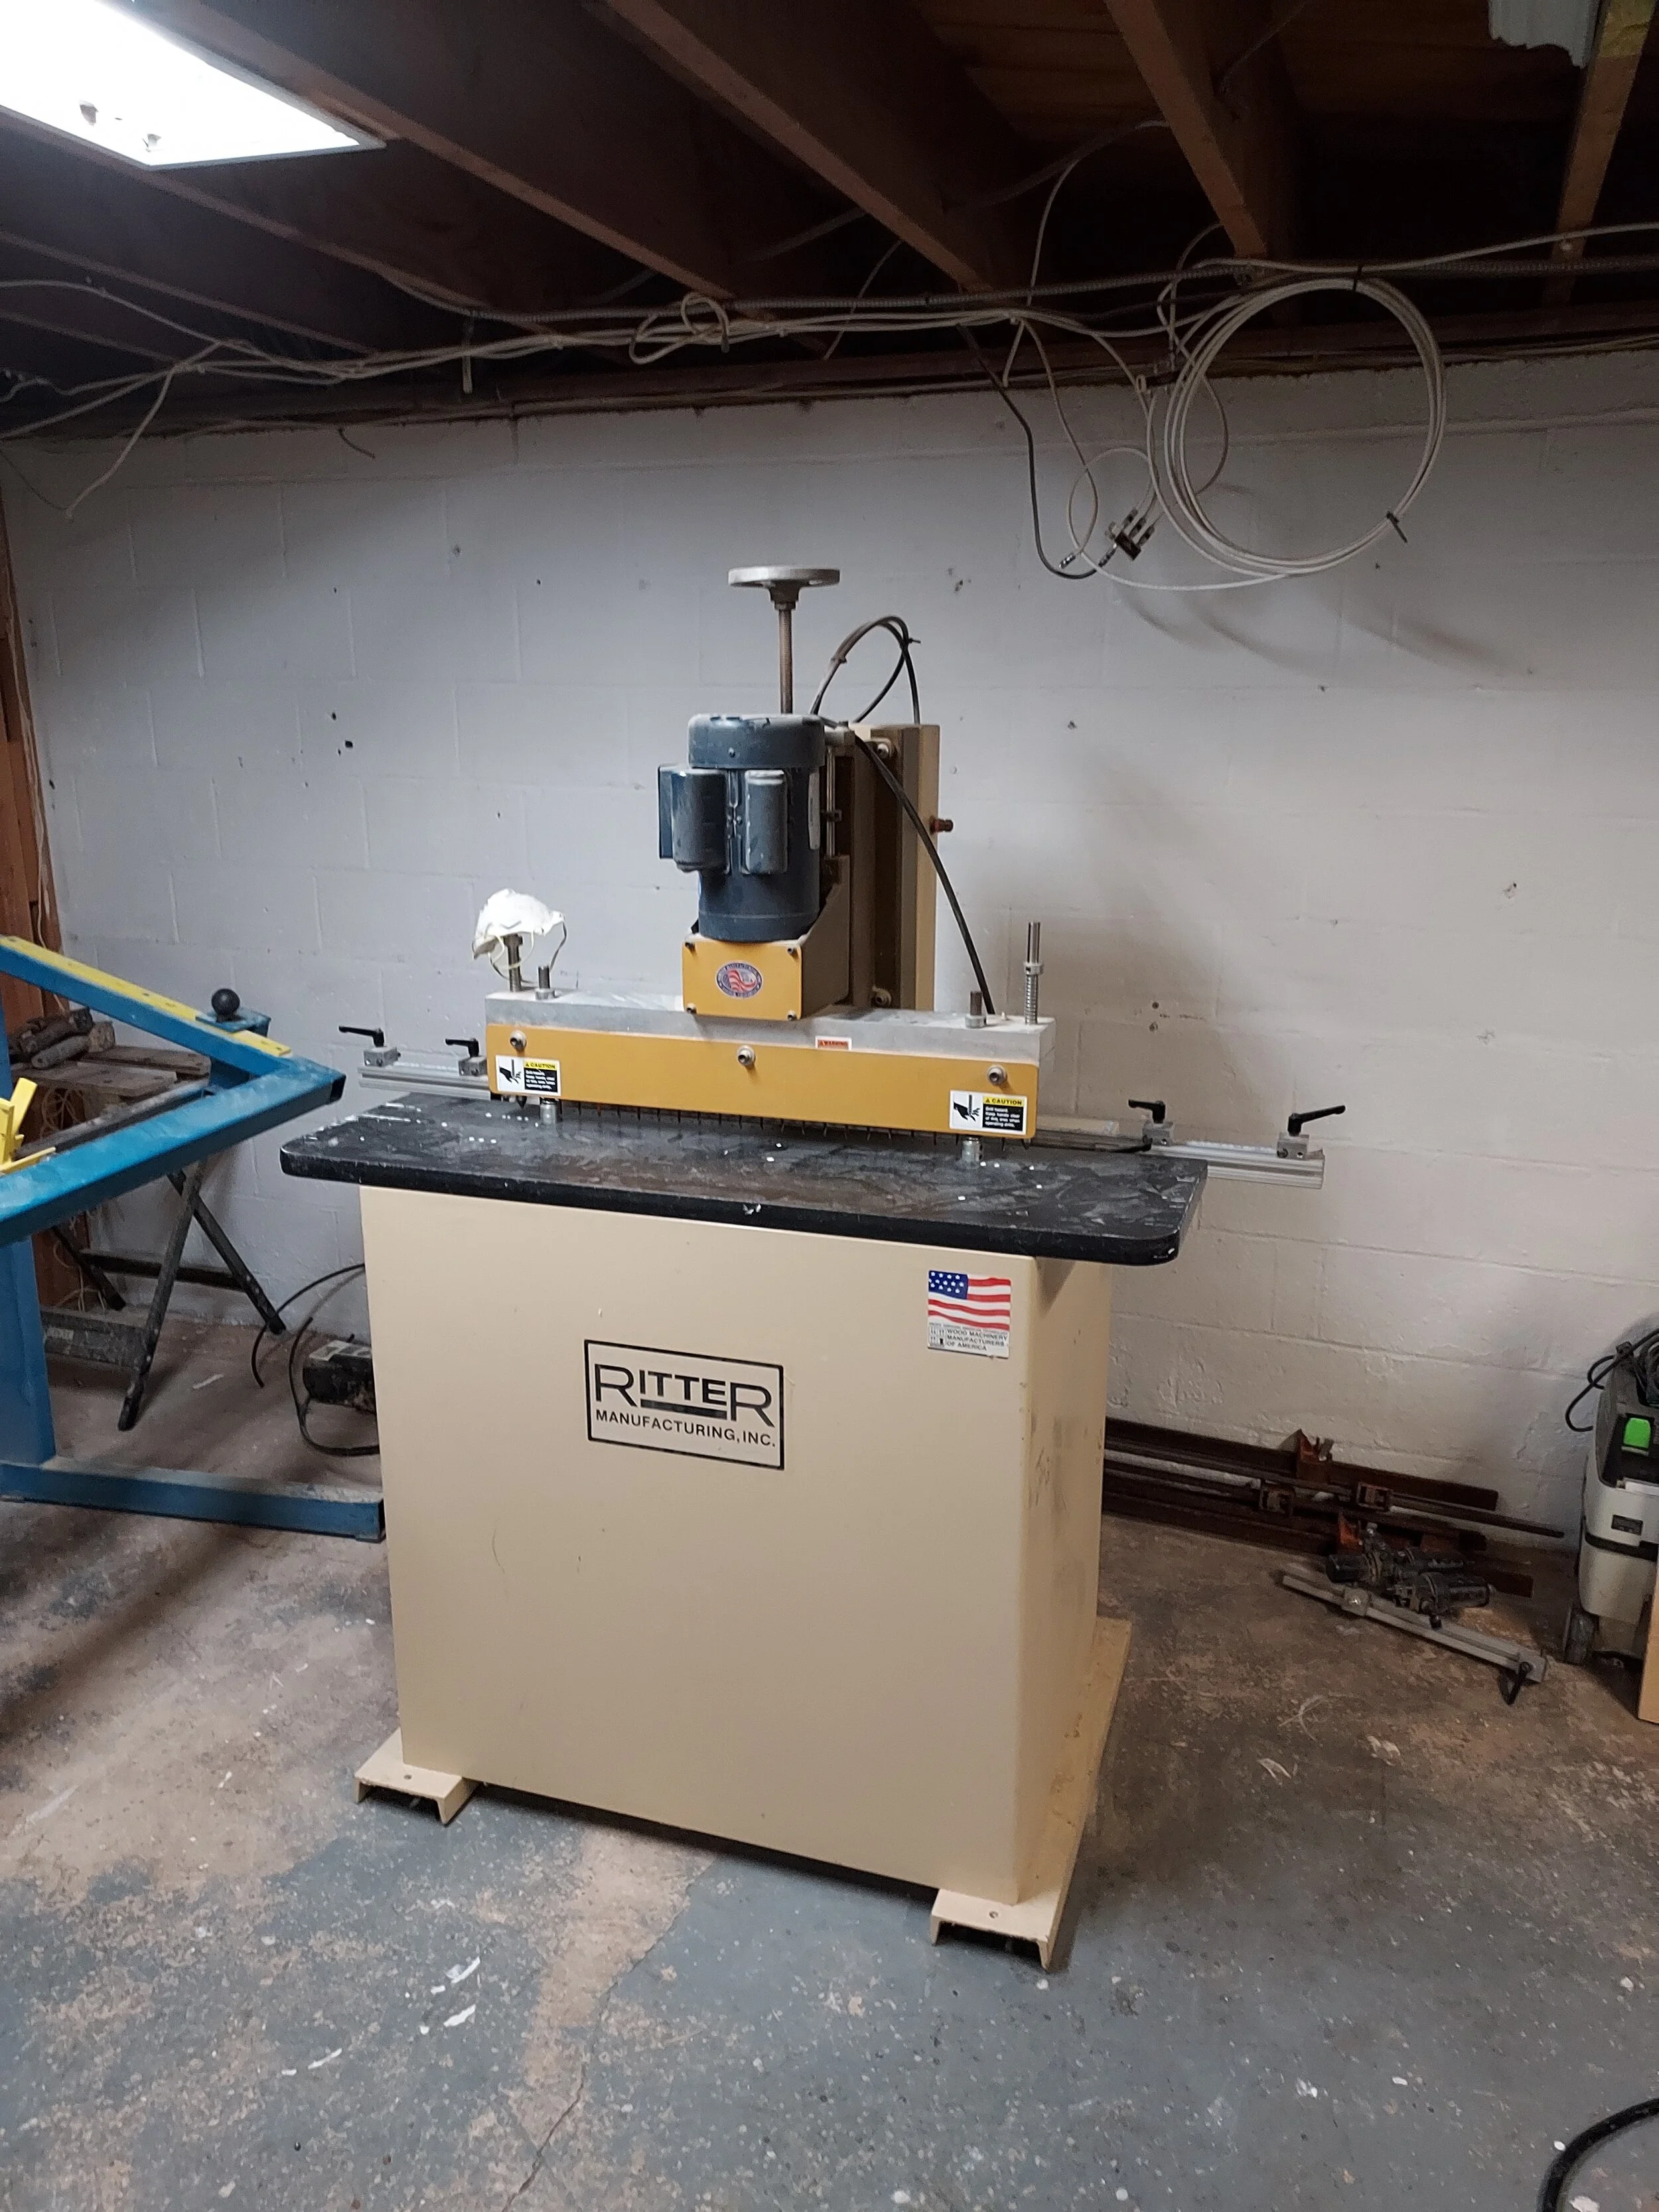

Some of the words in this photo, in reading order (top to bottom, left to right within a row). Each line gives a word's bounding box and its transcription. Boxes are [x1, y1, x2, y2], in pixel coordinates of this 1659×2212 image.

[947, 1335, 1004, 1347] MANUFACTURERS
[970, 1331, 1007, 1341] MACHINERY
[958, 1343, 987, 1351] AMERICA
[595, 1363, 775, 1428] RITTER
